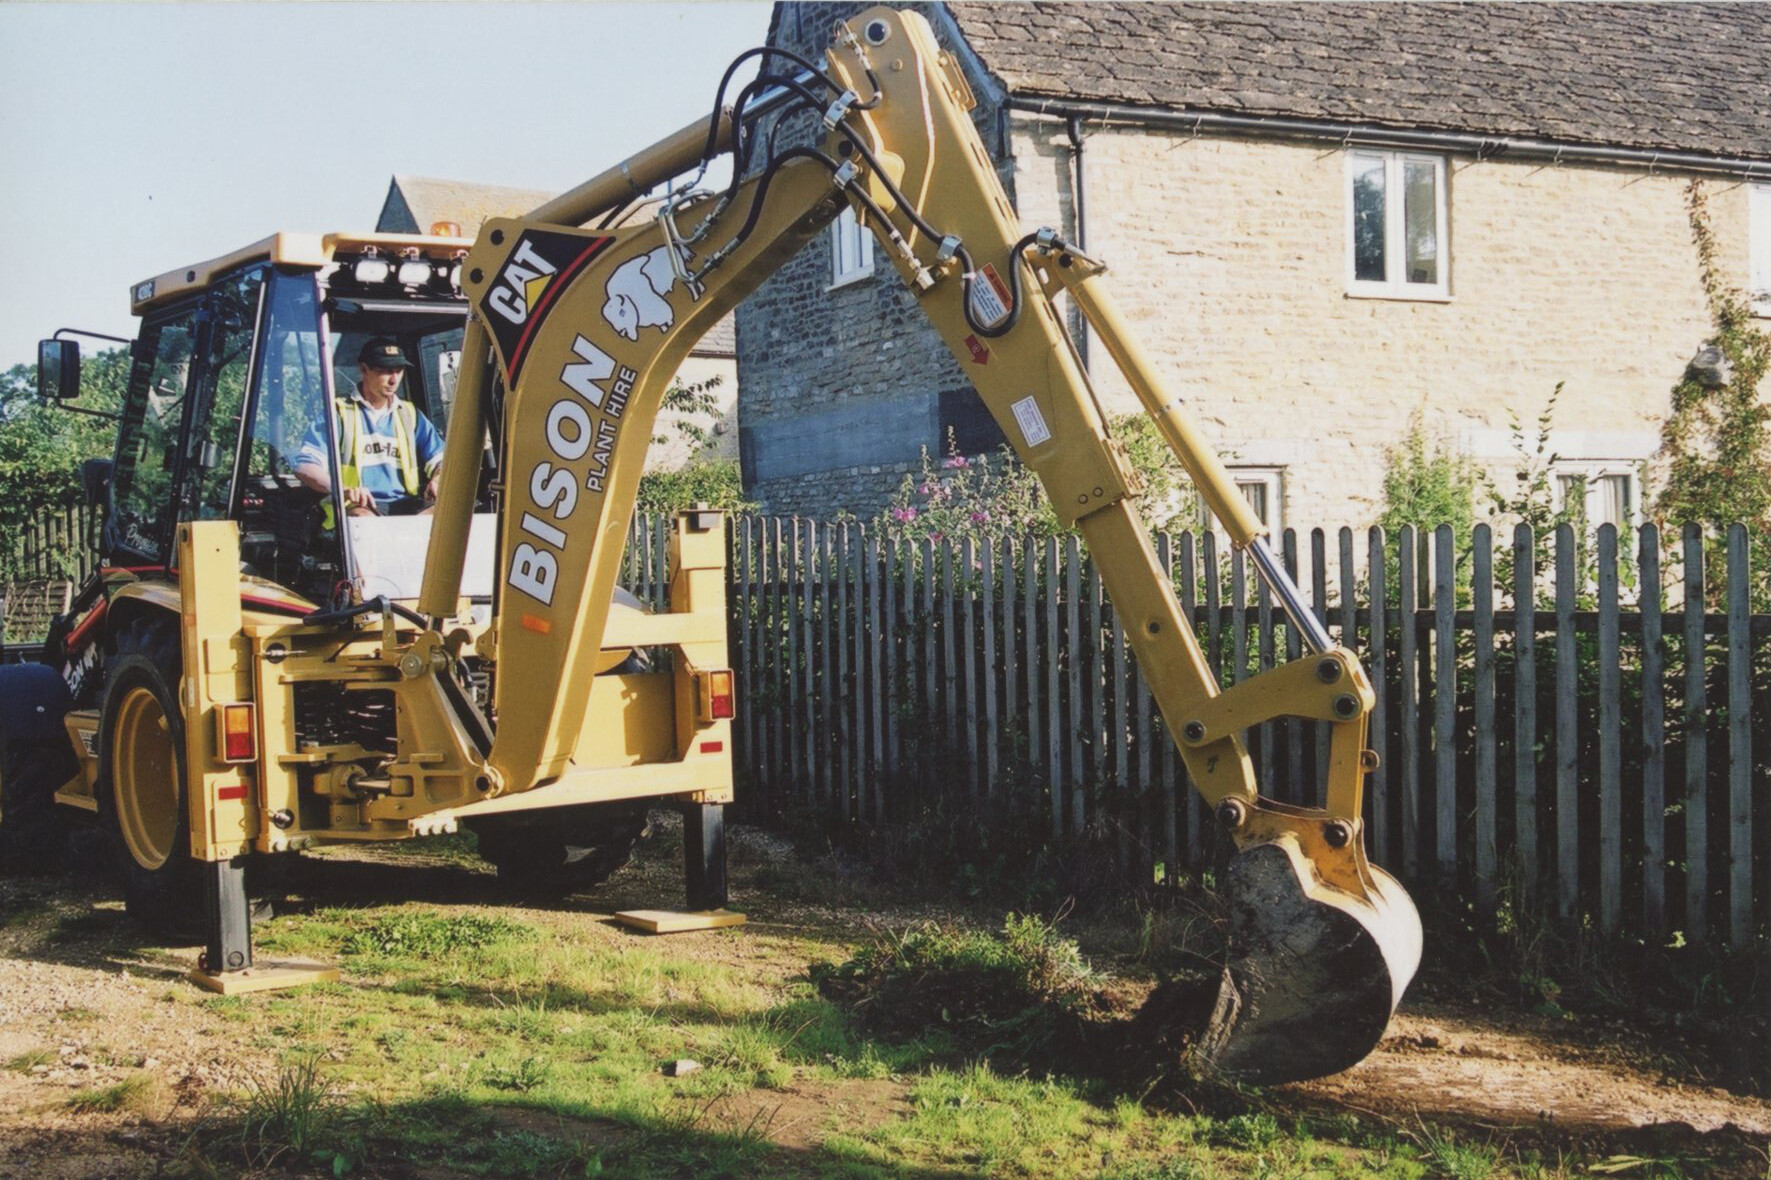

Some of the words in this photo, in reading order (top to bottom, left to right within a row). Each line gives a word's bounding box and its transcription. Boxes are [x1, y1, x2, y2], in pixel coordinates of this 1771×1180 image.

[489, 240, 556, 325] CAT
[509, 333, 617, 606] BISON
[586, 417, 618, 492] PLANT
[604, 365, 639, 420] HIRE
